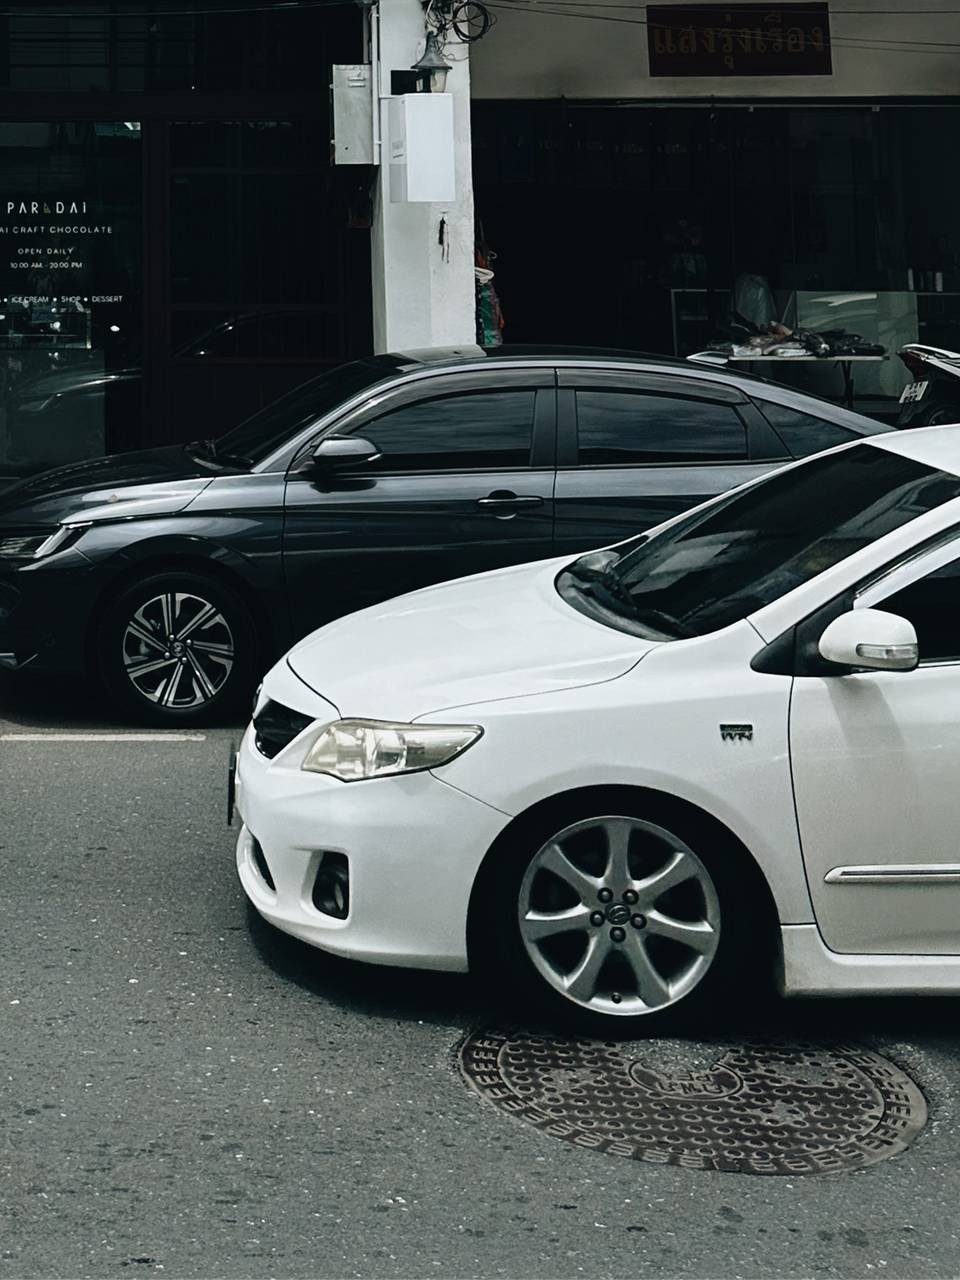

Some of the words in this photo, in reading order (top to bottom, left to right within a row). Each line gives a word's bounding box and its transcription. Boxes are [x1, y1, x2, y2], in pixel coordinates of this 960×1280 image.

[12, 226, 45, 234] CRAFT
[50, 226, 112, 234] CHOCOLATE
[61, 296, 81, 304] SHOP
[91, 295, 123, 303] DESSERT
